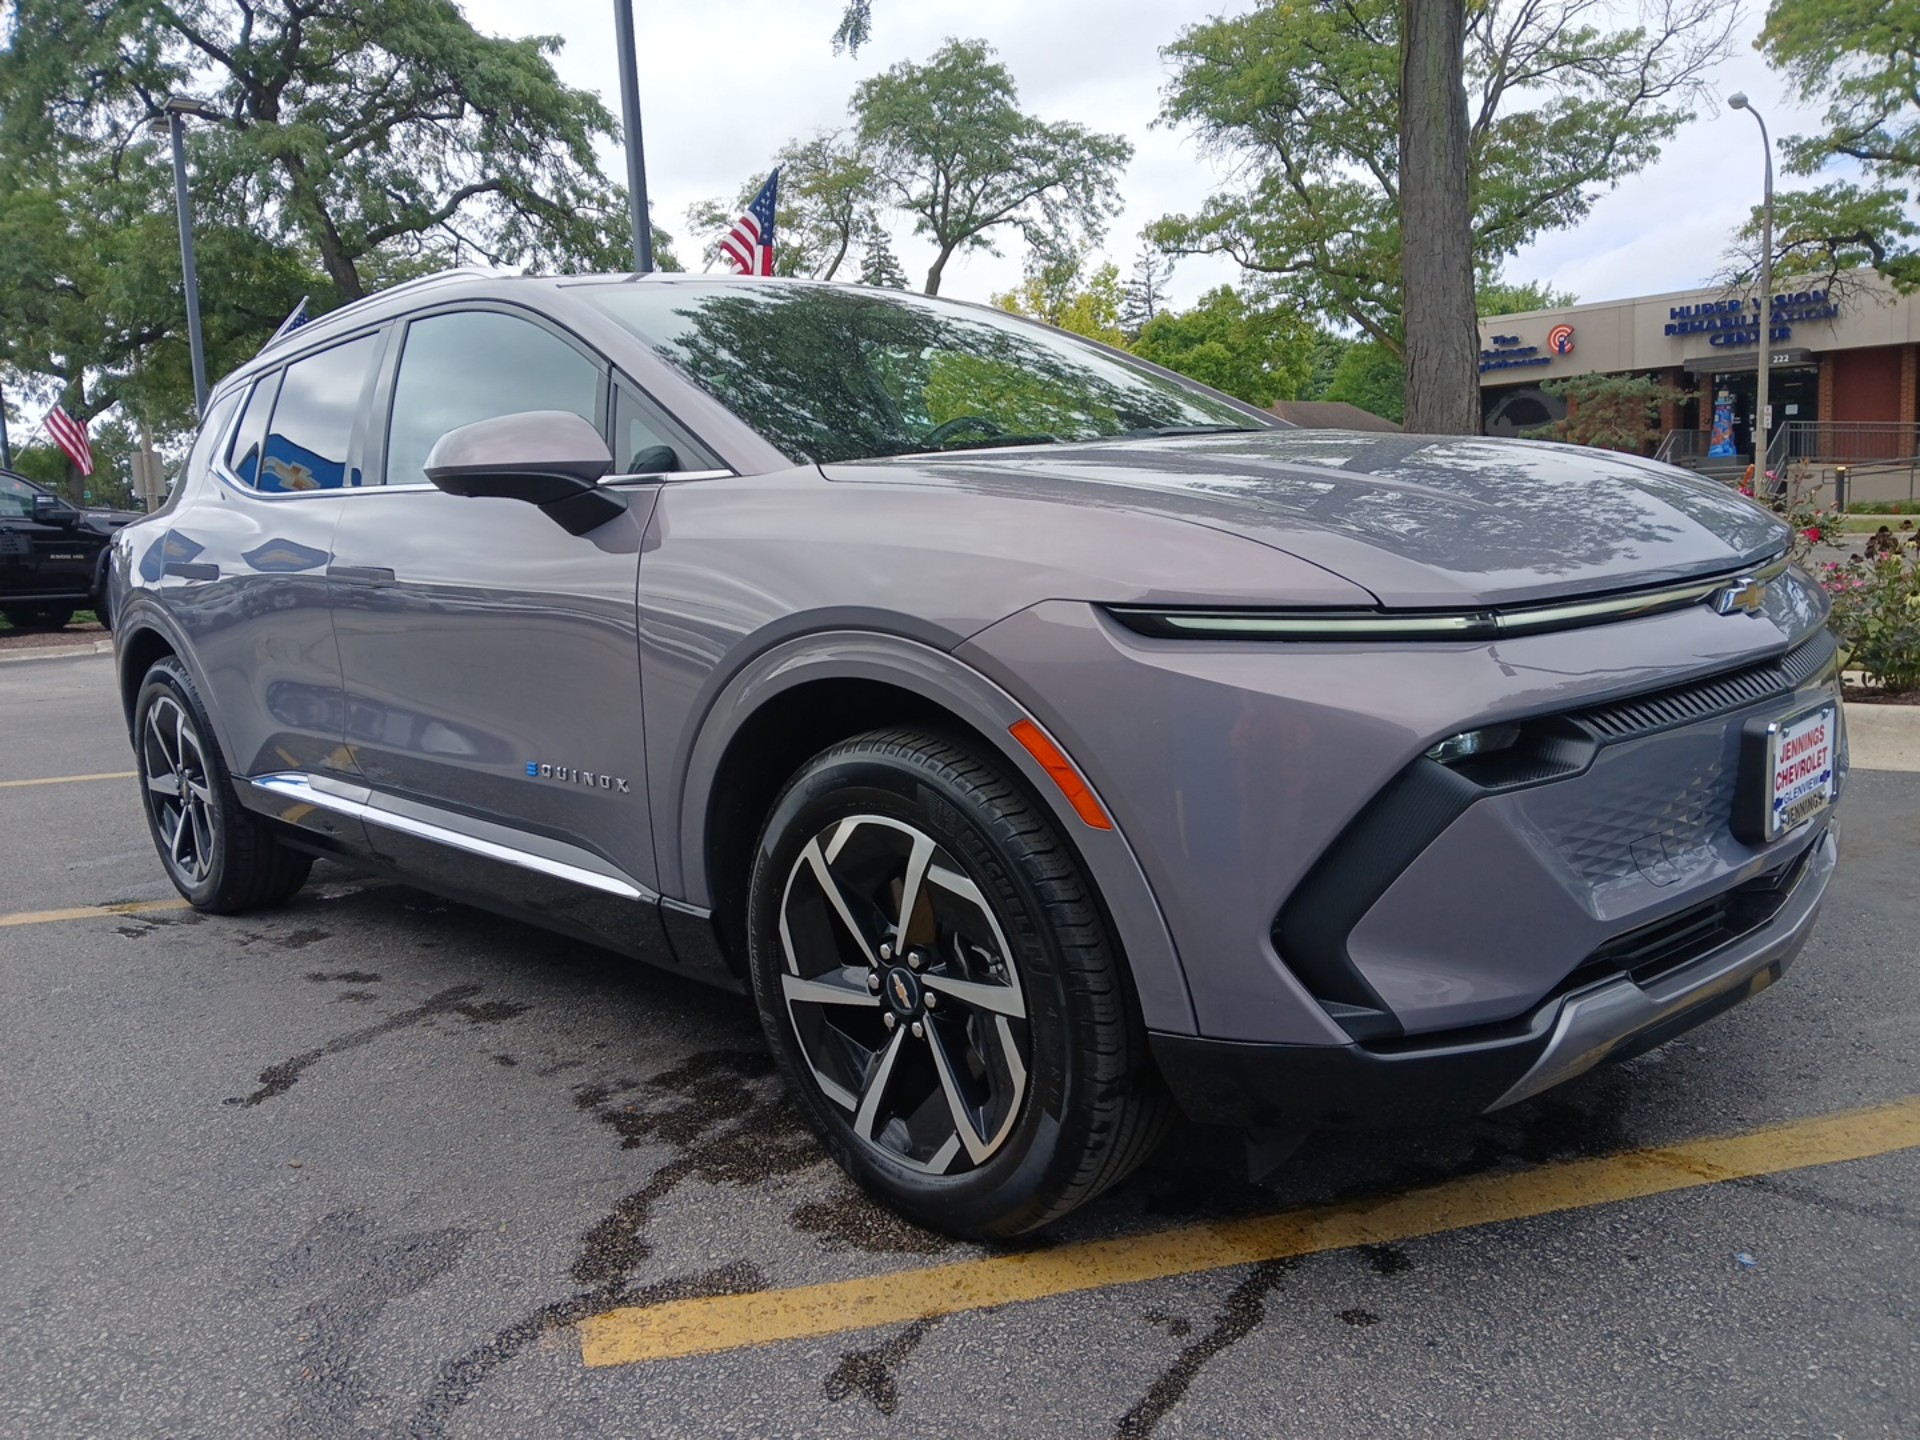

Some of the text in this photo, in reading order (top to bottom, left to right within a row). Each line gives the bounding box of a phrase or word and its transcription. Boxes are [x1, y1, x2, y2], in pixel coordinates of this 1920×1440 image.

[1665, 304, 1838, 336] REHABILIATION
[1670, 289, 1828, 320] HUBER VSION
[1490, 335, 1520, 345] The
[1709, 327, 1792, 346] CENER
[1773, 354, 1789, 364] 222
[1780, 724, 1825, 764] JENNINGS
[526, 760, 630, 793] EQUINOX
[1775, 746, 1828, 792] CHEVROLET
[1783, 776, 1821, 805] GLENVIEW
[1786, 794, 1823, 826] JENNINGS
[960, 829, 1044, 962] MICHELIN
